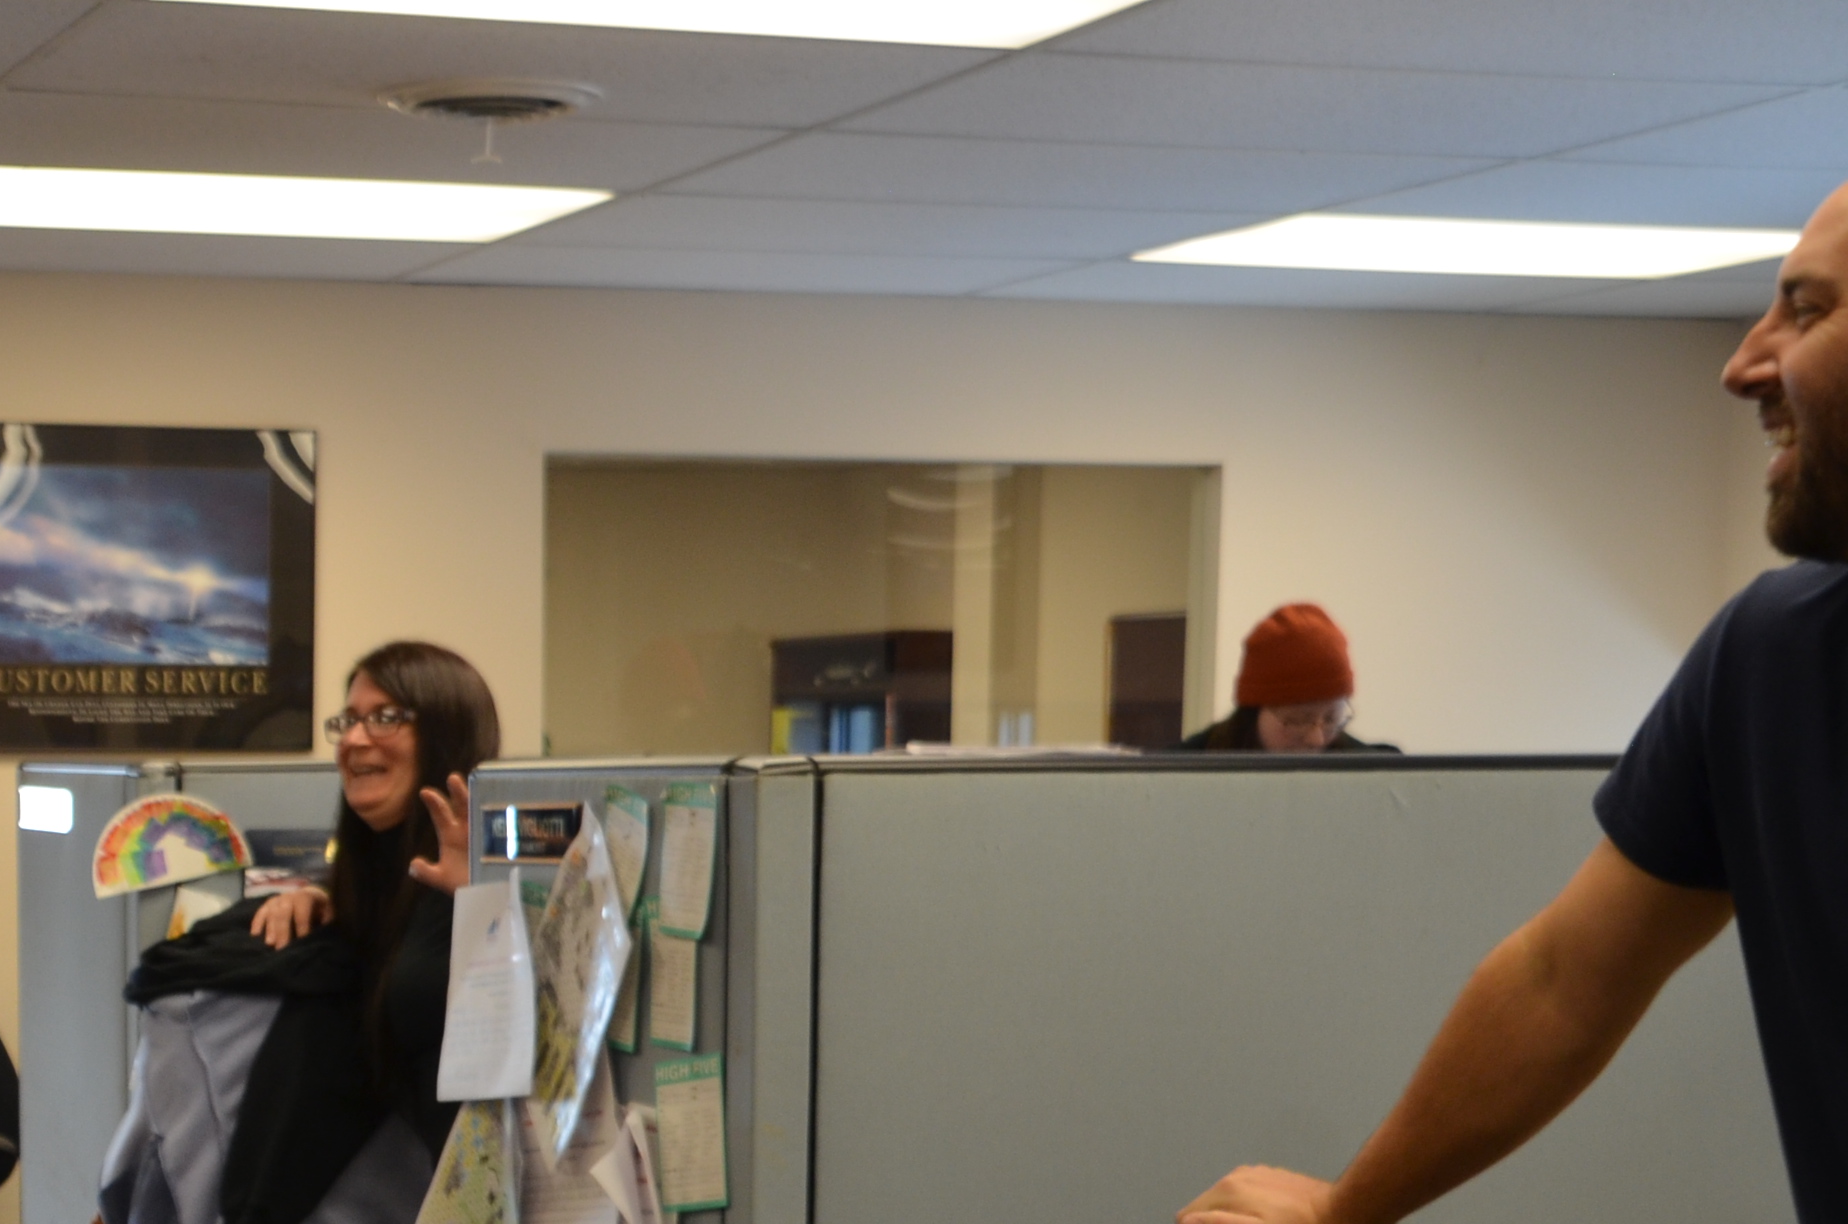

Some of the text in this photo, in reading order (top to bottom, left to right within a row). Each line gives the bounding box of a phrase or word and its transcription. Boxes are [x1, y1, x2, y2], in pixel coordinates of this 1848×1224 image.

[144, 669, 268, 695] SERVICE
[655, 1057, 719, 1081] HIGH FIVE
